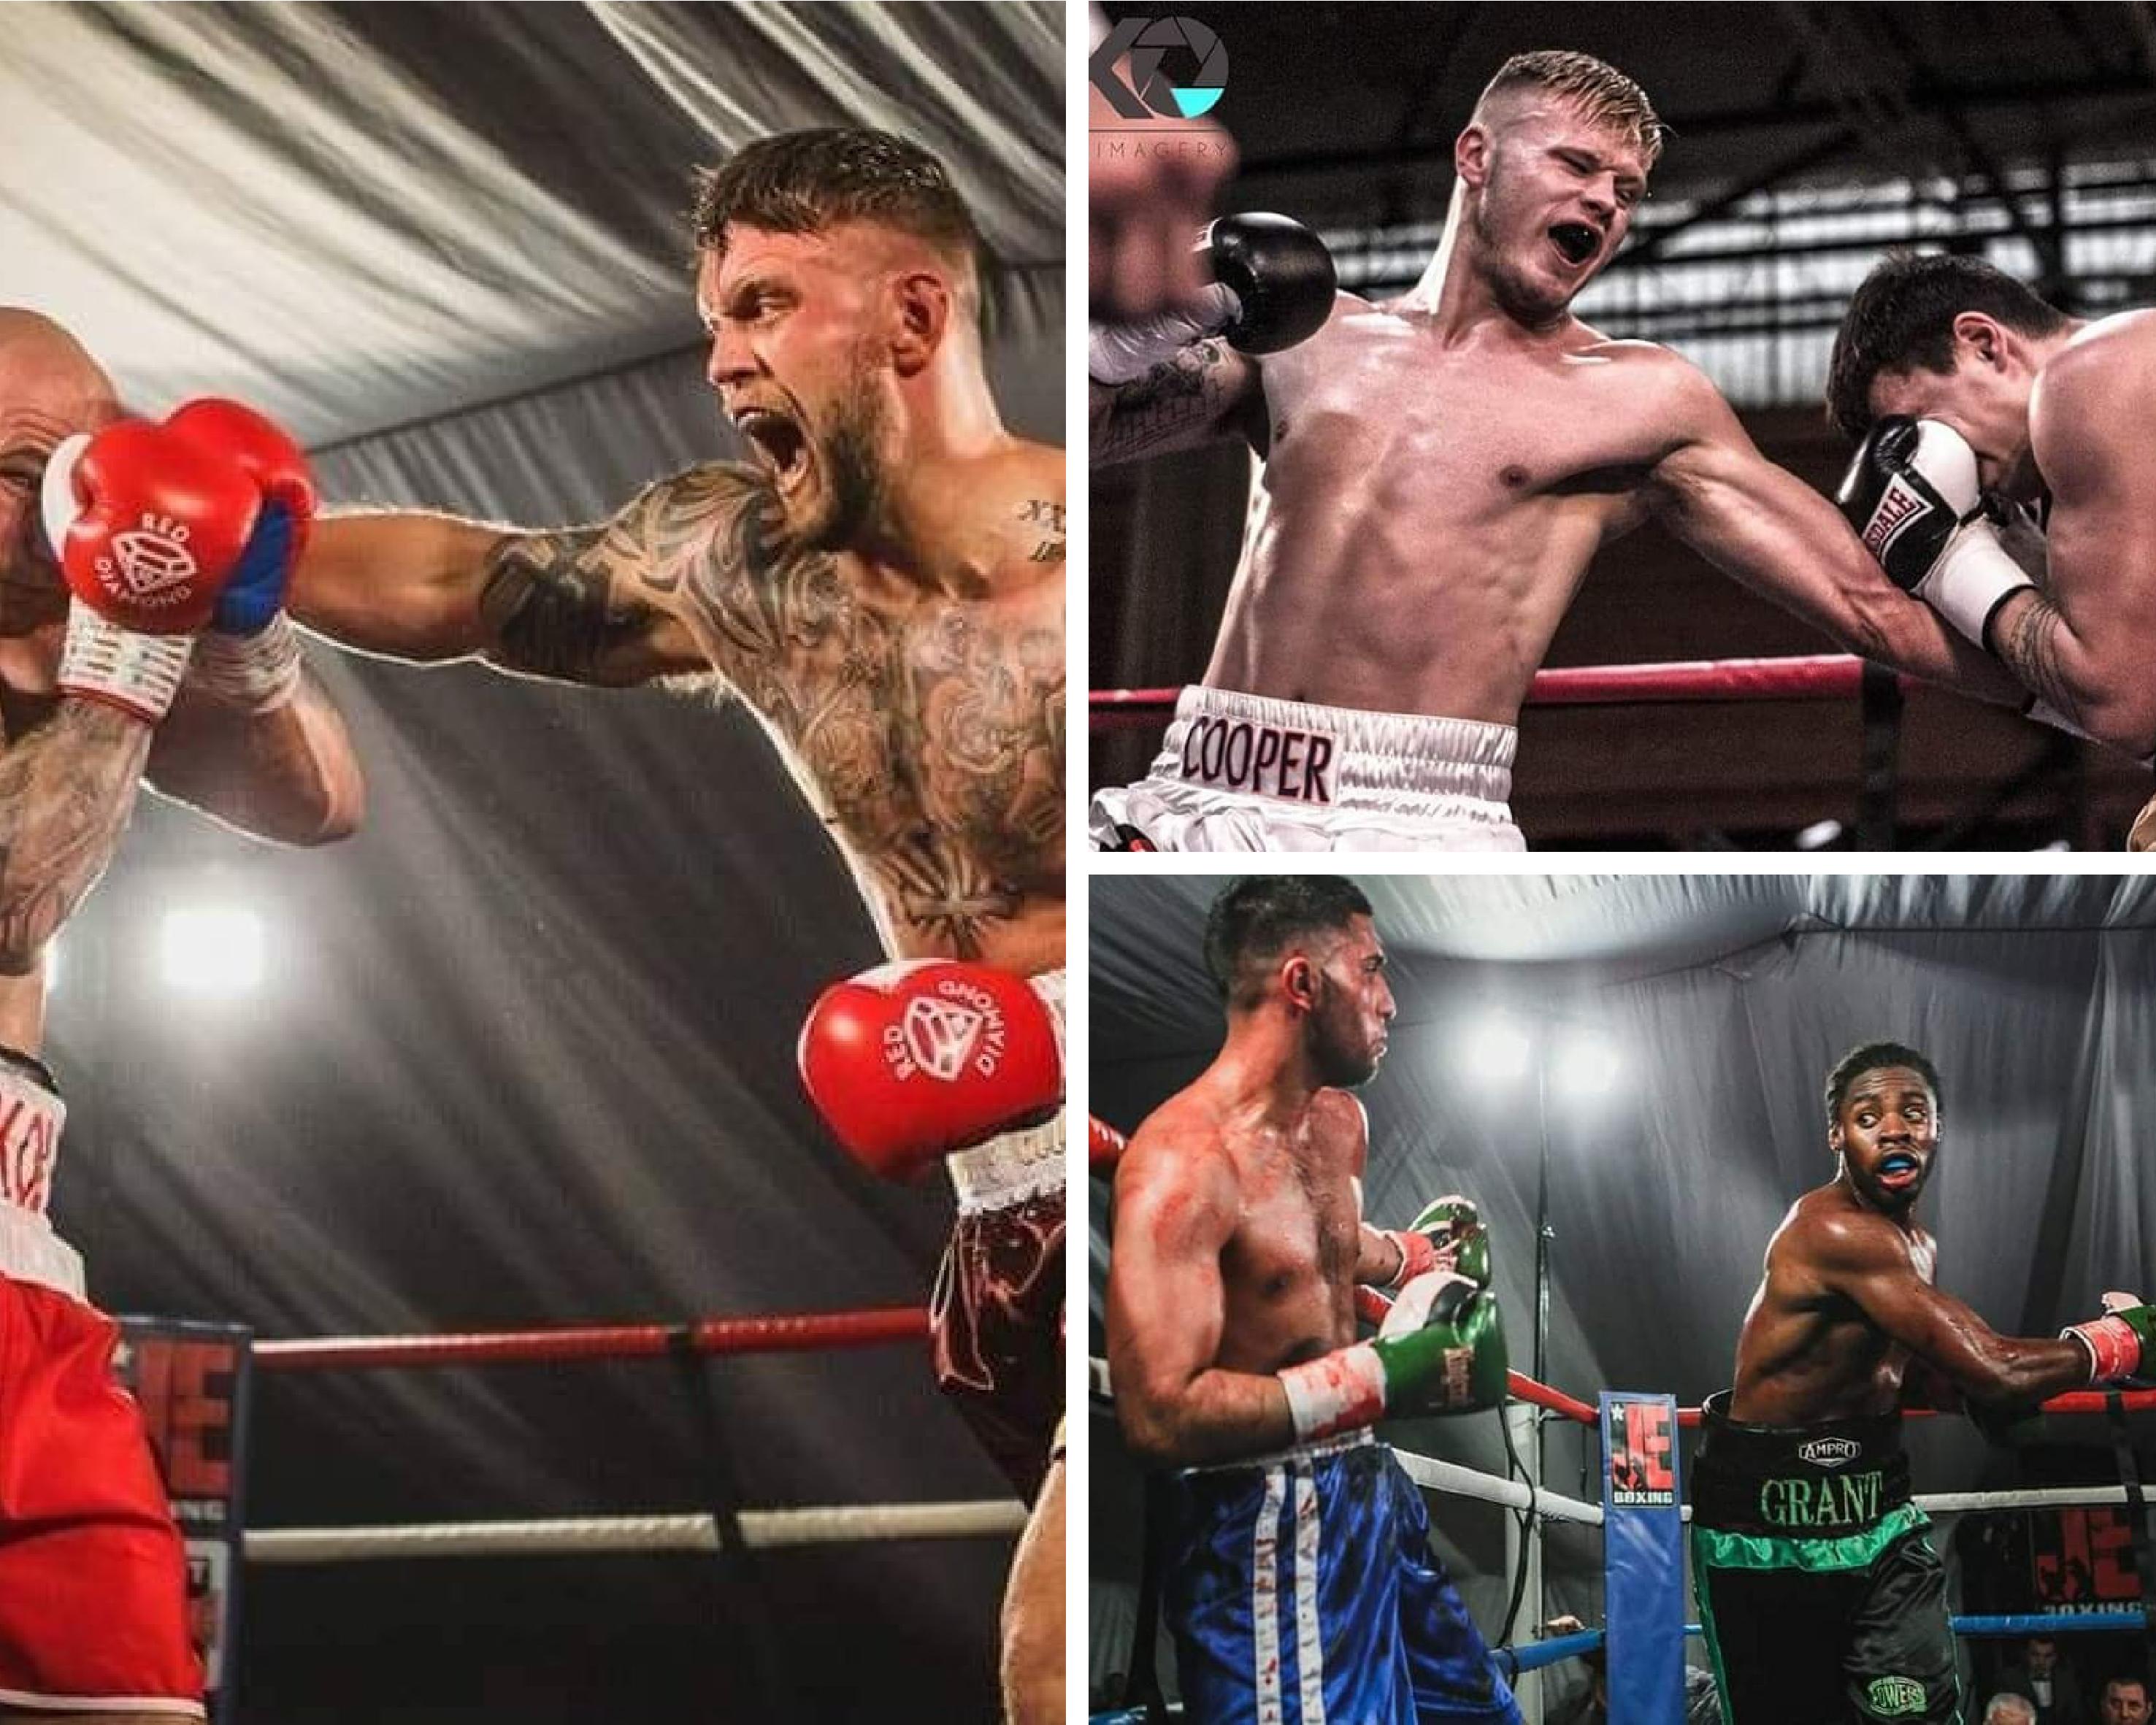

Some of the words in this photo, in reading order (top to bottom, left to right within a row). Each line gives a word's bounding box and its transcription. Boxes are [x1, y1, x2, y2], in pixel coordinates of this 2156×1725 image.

[142, 512, 191, 543] RED
[1182, 715, 1333, 803] COOPER
[883, 1025, 917, 1081] RED
[938, 980, 1005, 1077] DIAMOND
[1614, 1491, 1673, 1504] BOXING
[1761, 1470, 1882, 1526] GRANT
